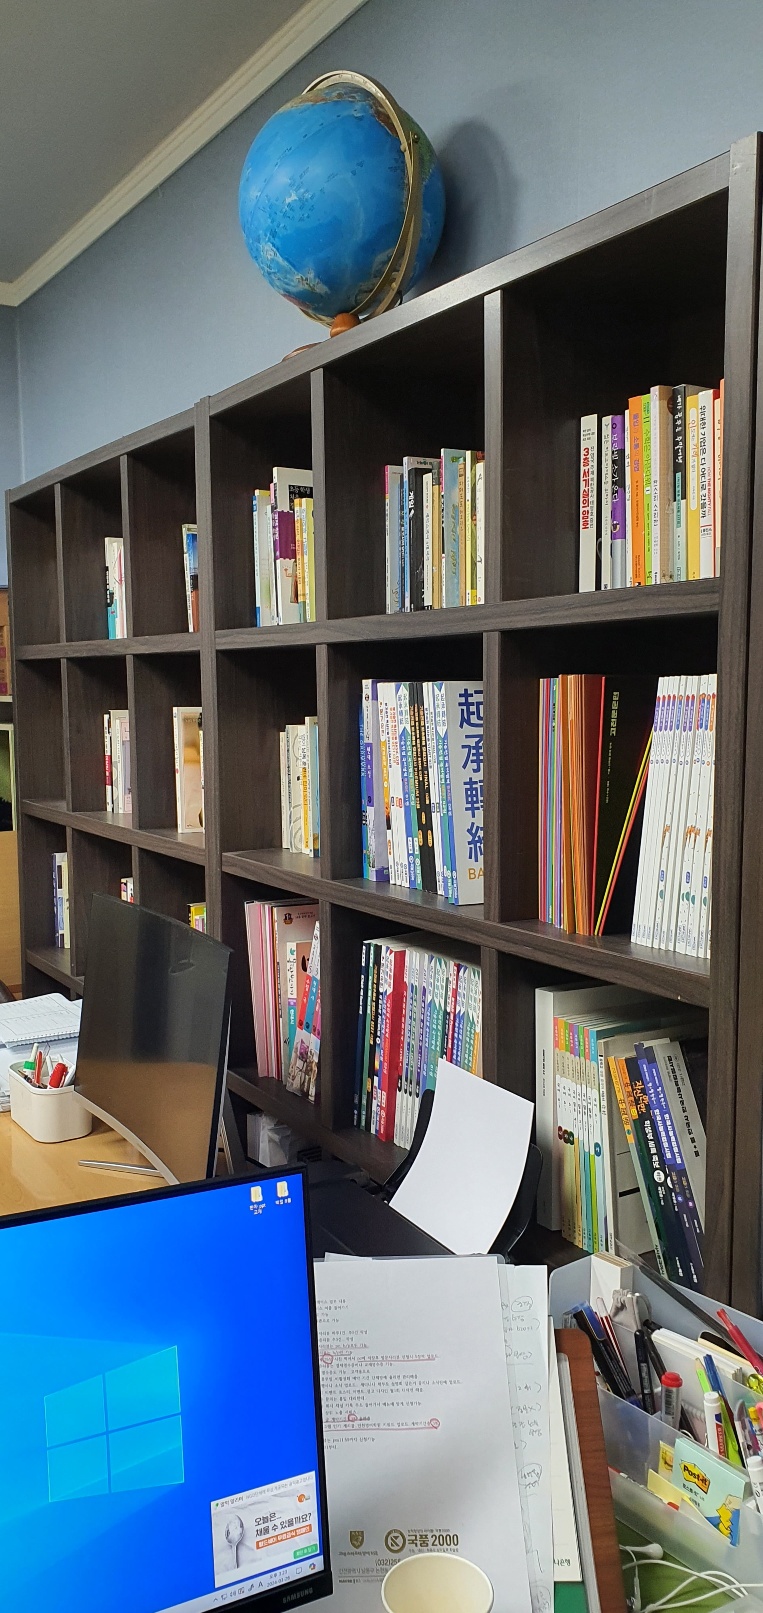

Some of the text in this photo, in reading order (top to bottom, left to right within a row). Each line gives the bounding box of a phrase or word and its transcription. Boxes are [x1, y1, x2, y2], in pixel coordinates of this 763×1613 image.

[582, 447, 590, 467] 3층
[682, 1464, 708, 1487] Post-it
[255, 1512, 312, 1538] 채울 수 있을까요?
[282, 1587, 314, 1604] SAMSUNG
